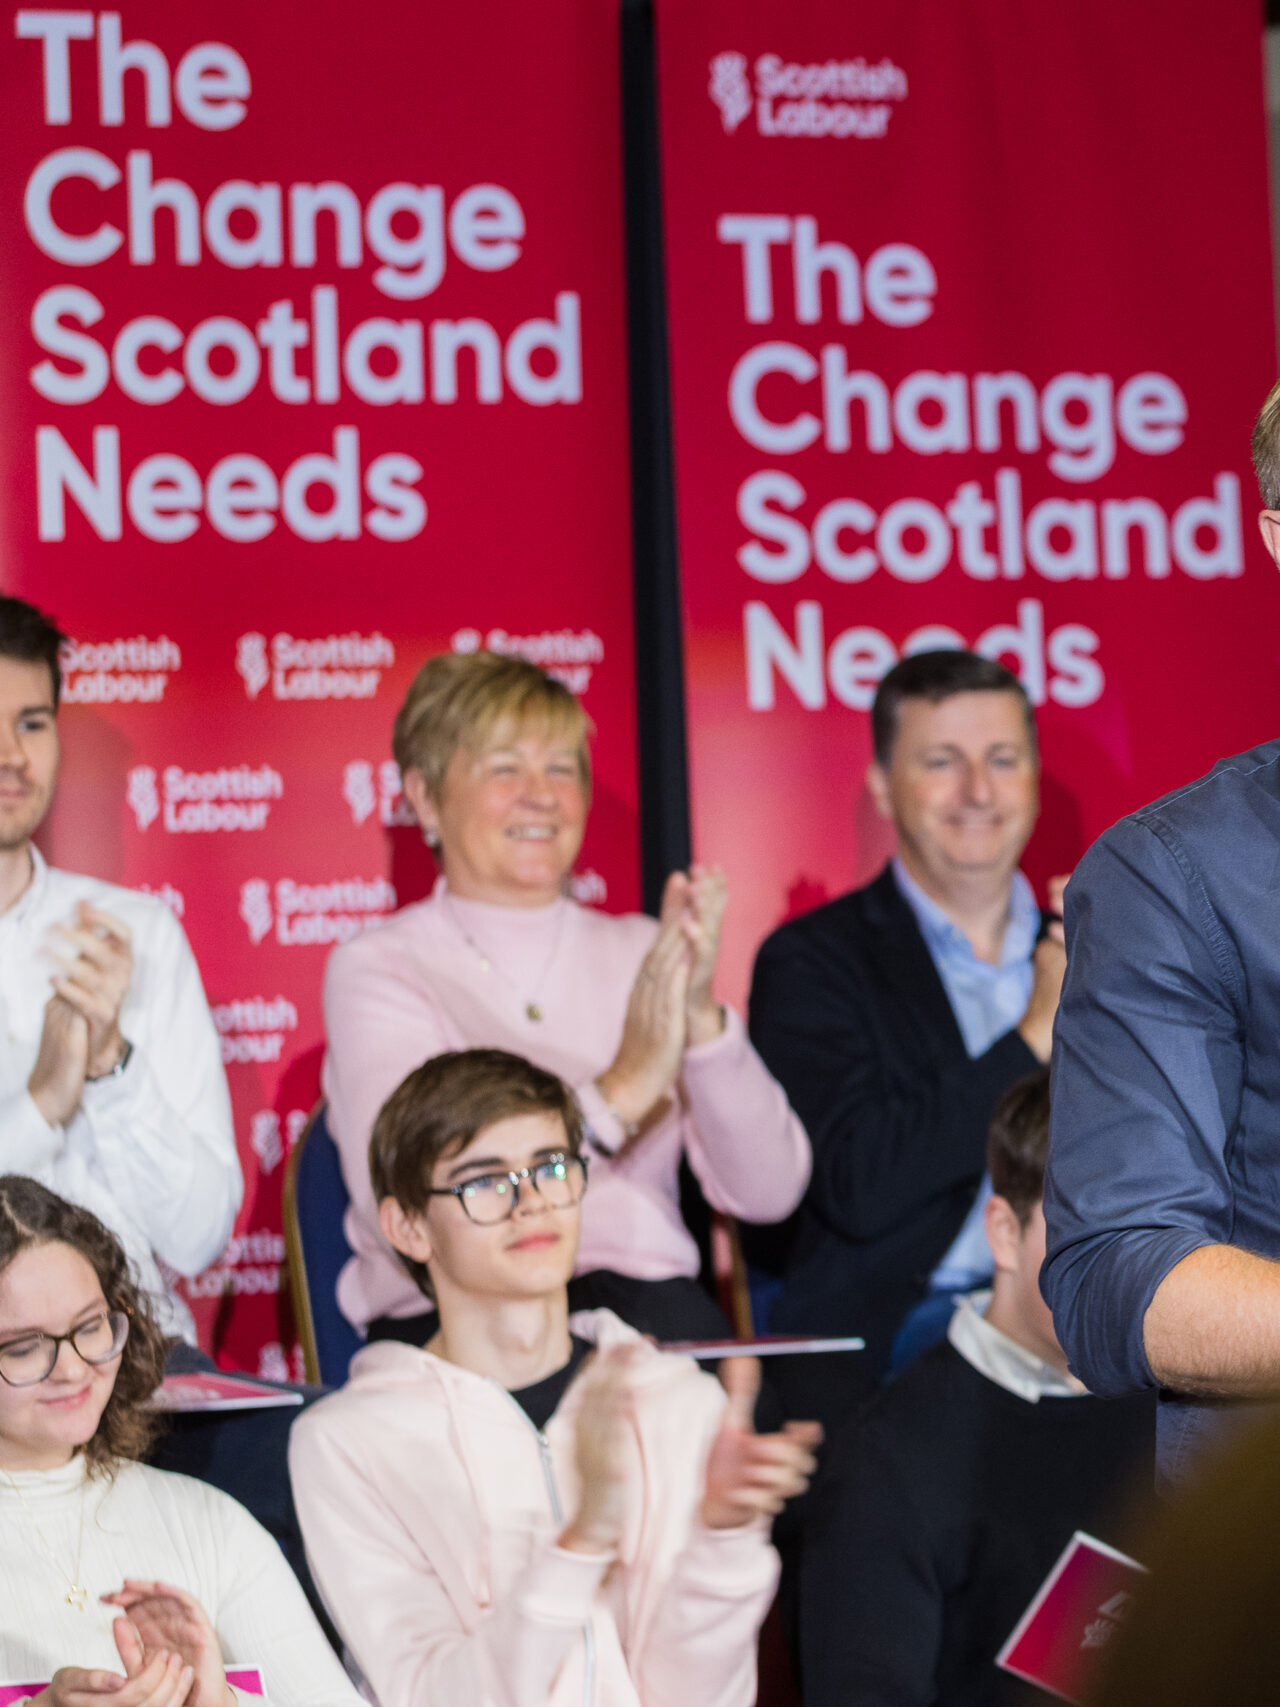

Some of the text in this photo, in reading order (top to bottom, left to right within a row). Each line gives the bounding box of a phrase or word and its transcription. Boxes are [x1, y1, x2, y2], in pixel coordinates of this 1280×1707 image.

[15, 11, 251, 130] The
[756, 54, 908, 101] Scottish
[757, 97, 891, 139] Labour
[24, 147, 525, 299] Change
[718, 215, 936, 326] The
[30, 285, 583, 406] Scotland
[729, 342, 1188, 482] Change
[36, 425, 428, 543] Needs
[738, 467, 1244, 584] Scotland
[59, 634, 181, 673] Scottish
[272, 631, 395, 670] Scottish
[60, 671, 167, 703] Labour
[273, 669, 382, 700] Labour
[164, 763, 284, 801] Scottish
[164, 799, 270, 833] Labour
[276, 876, 398, 912] Scottish
